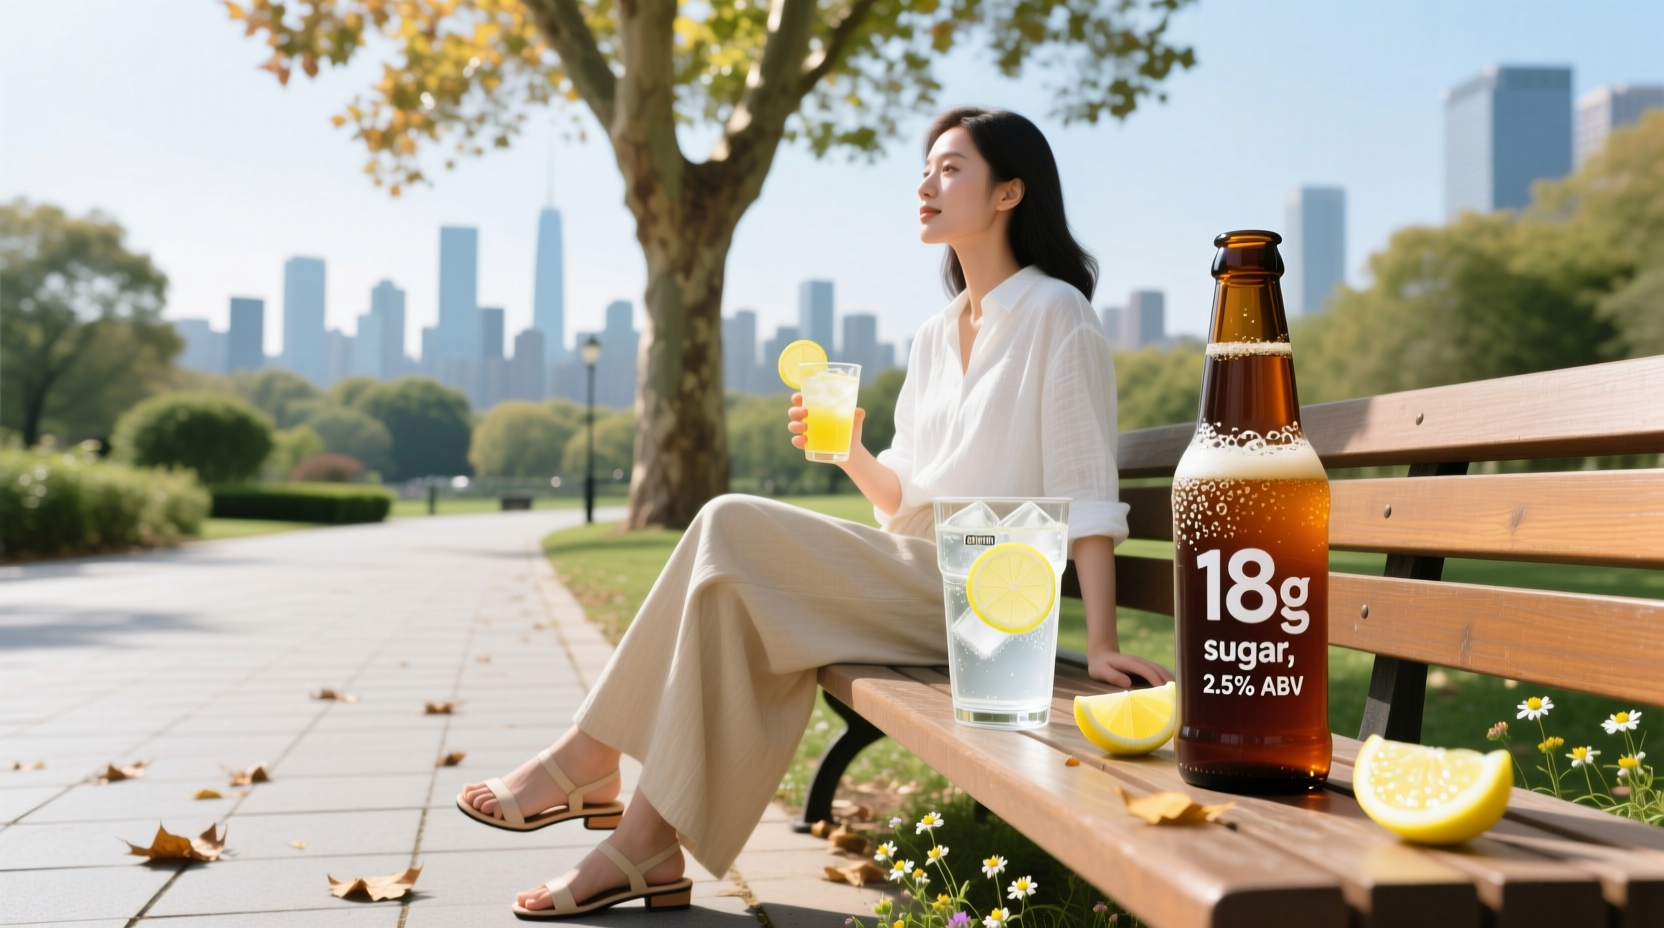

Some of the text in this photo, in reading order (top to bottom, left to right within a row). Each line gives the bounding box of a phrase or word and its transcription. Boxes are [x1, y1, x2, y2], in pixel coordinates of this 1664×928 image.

[1195, 547, 1311, 635] 18g
[1204, 639, 1295, 671] sugar,
[1203, 673, 1304, 697] 2.5% ABV
